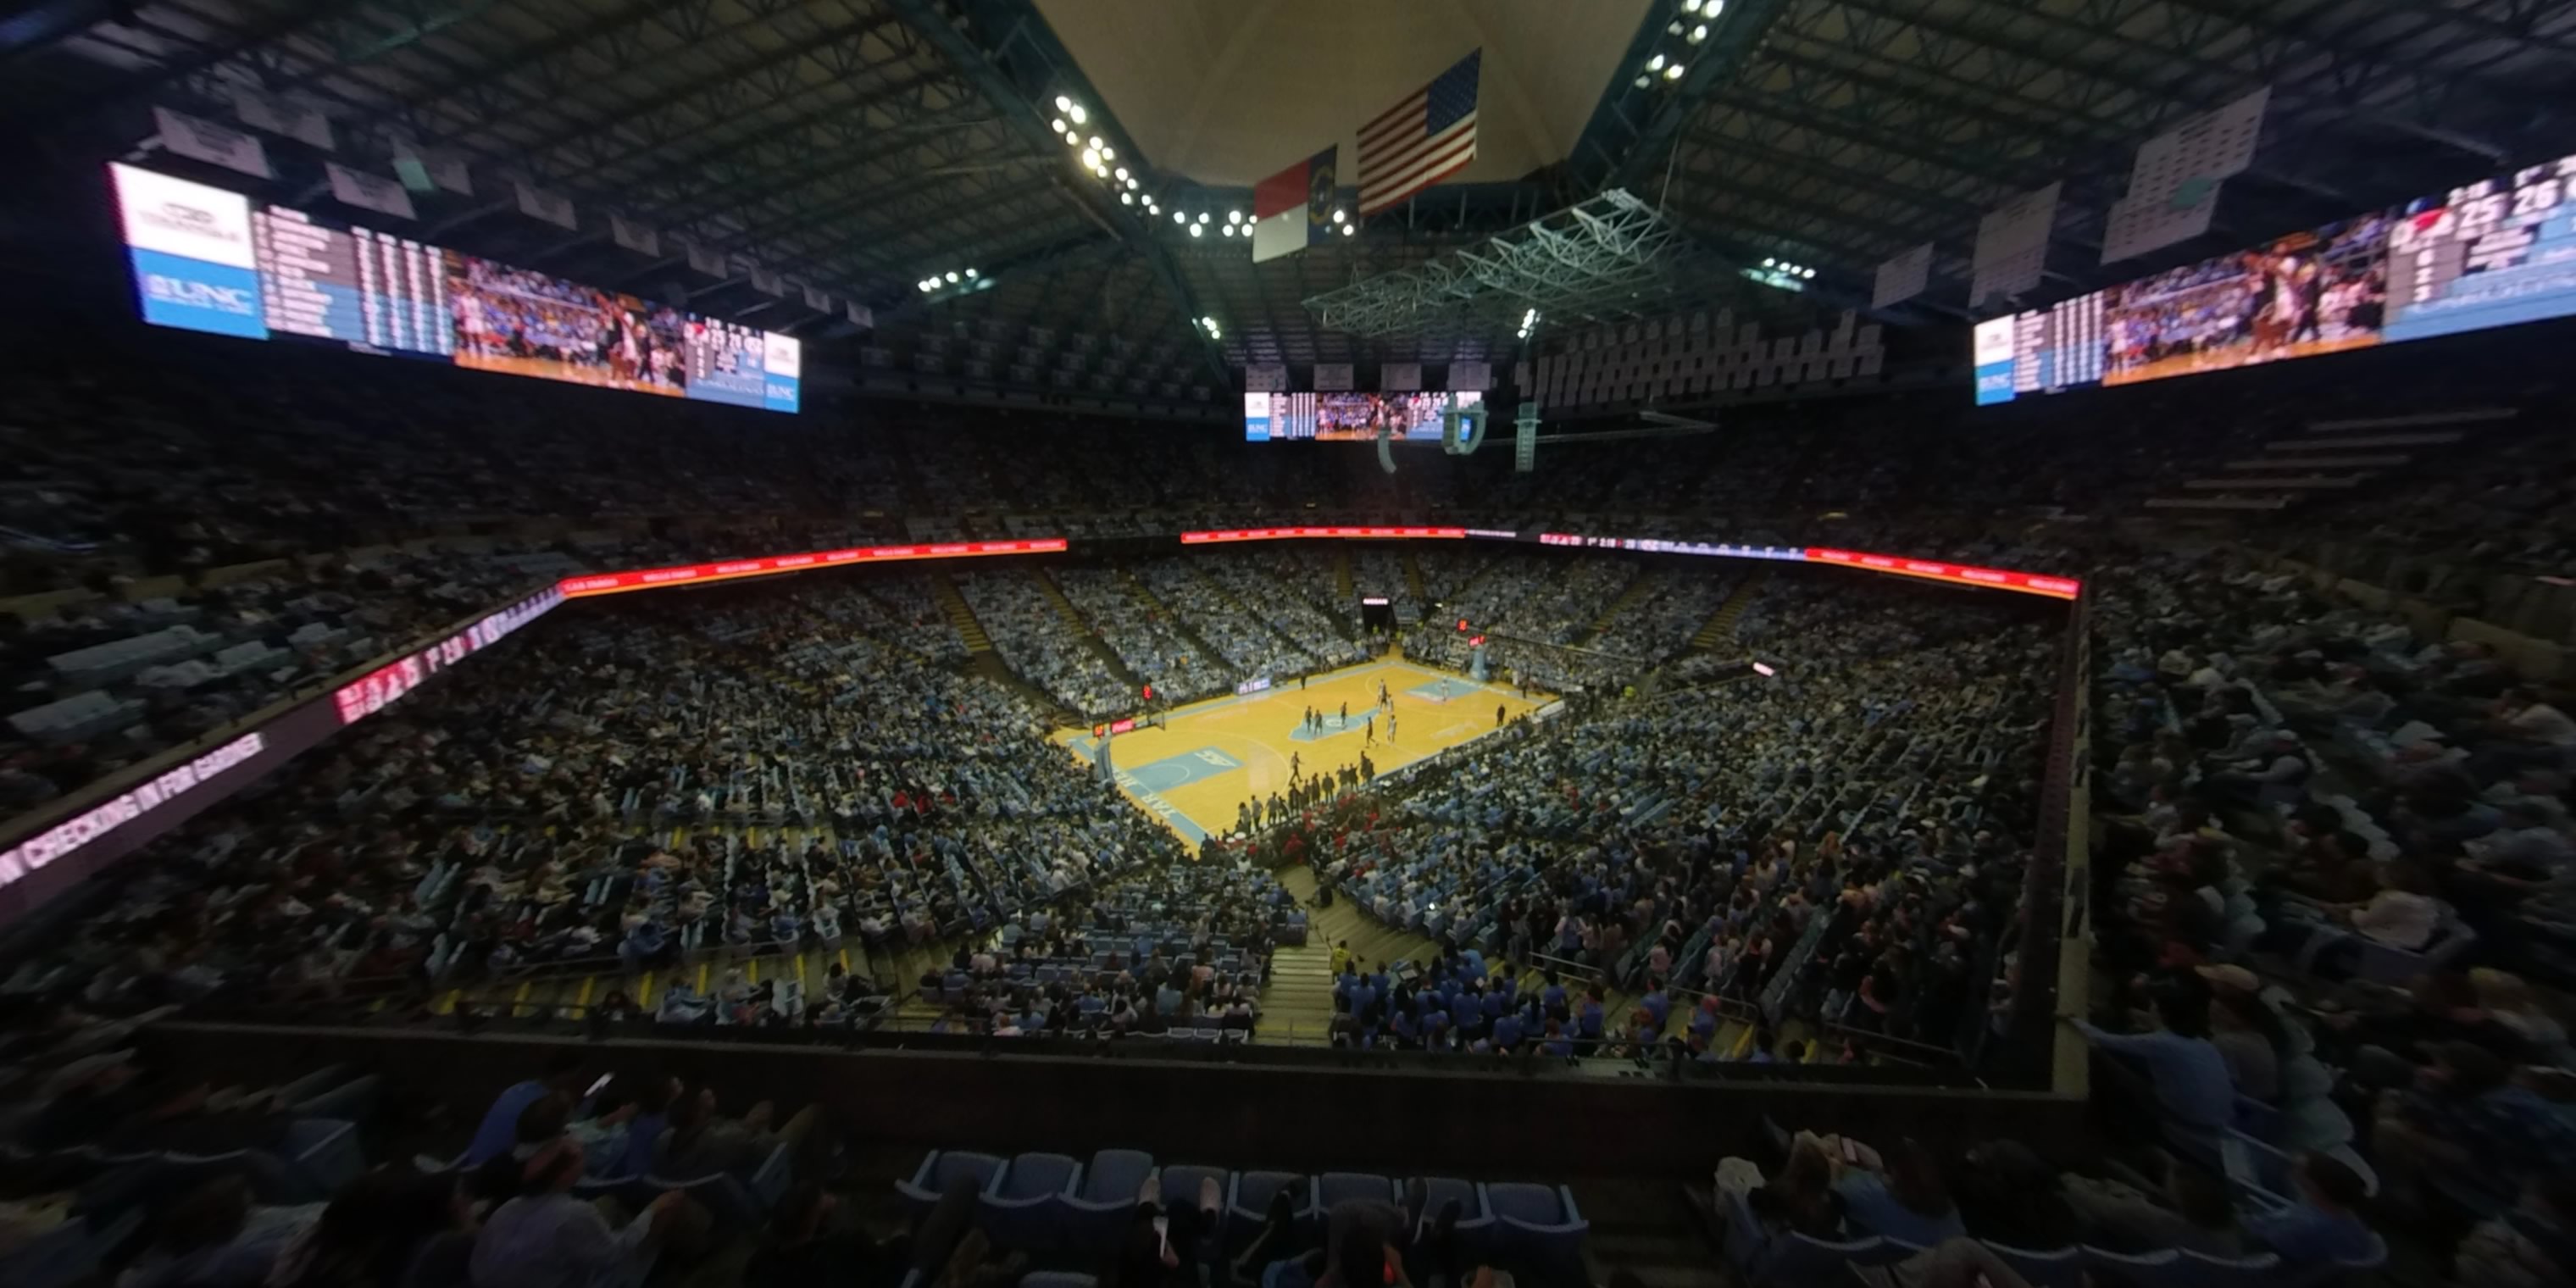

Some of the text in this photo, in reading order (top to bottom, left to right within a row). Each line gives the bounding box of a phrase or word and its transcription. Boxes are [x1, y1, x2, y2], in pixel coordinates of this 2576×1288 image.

[2460, 179, 2560, 228] 25 26
[169, 277, 253, 310] UNC
[136, 780, 163, 811] IN
[157, 764, 197, 799] FOR
